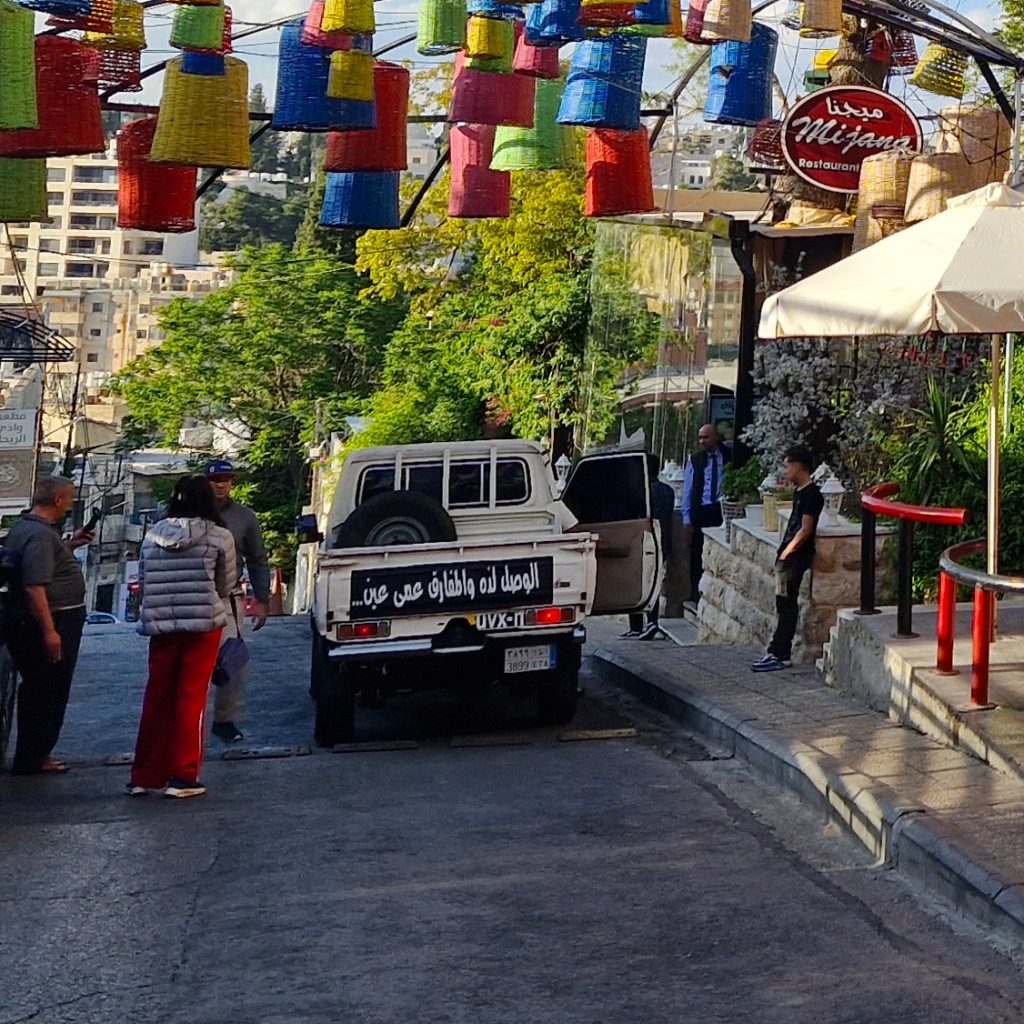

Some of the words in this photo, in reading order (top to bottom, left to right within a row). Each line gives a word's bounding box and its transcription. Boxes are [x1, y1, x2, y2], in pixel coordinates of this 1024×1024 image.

[825, 96, 884, 122] ميجنا
[791, 116, 914, 155] Mijana
[798, 158, 860, 173] Restaurant
[0, 412, 26, 421] مطع
[0, 434, 26, 445] الريحا
[501, 562, 540, 595] الوصل
